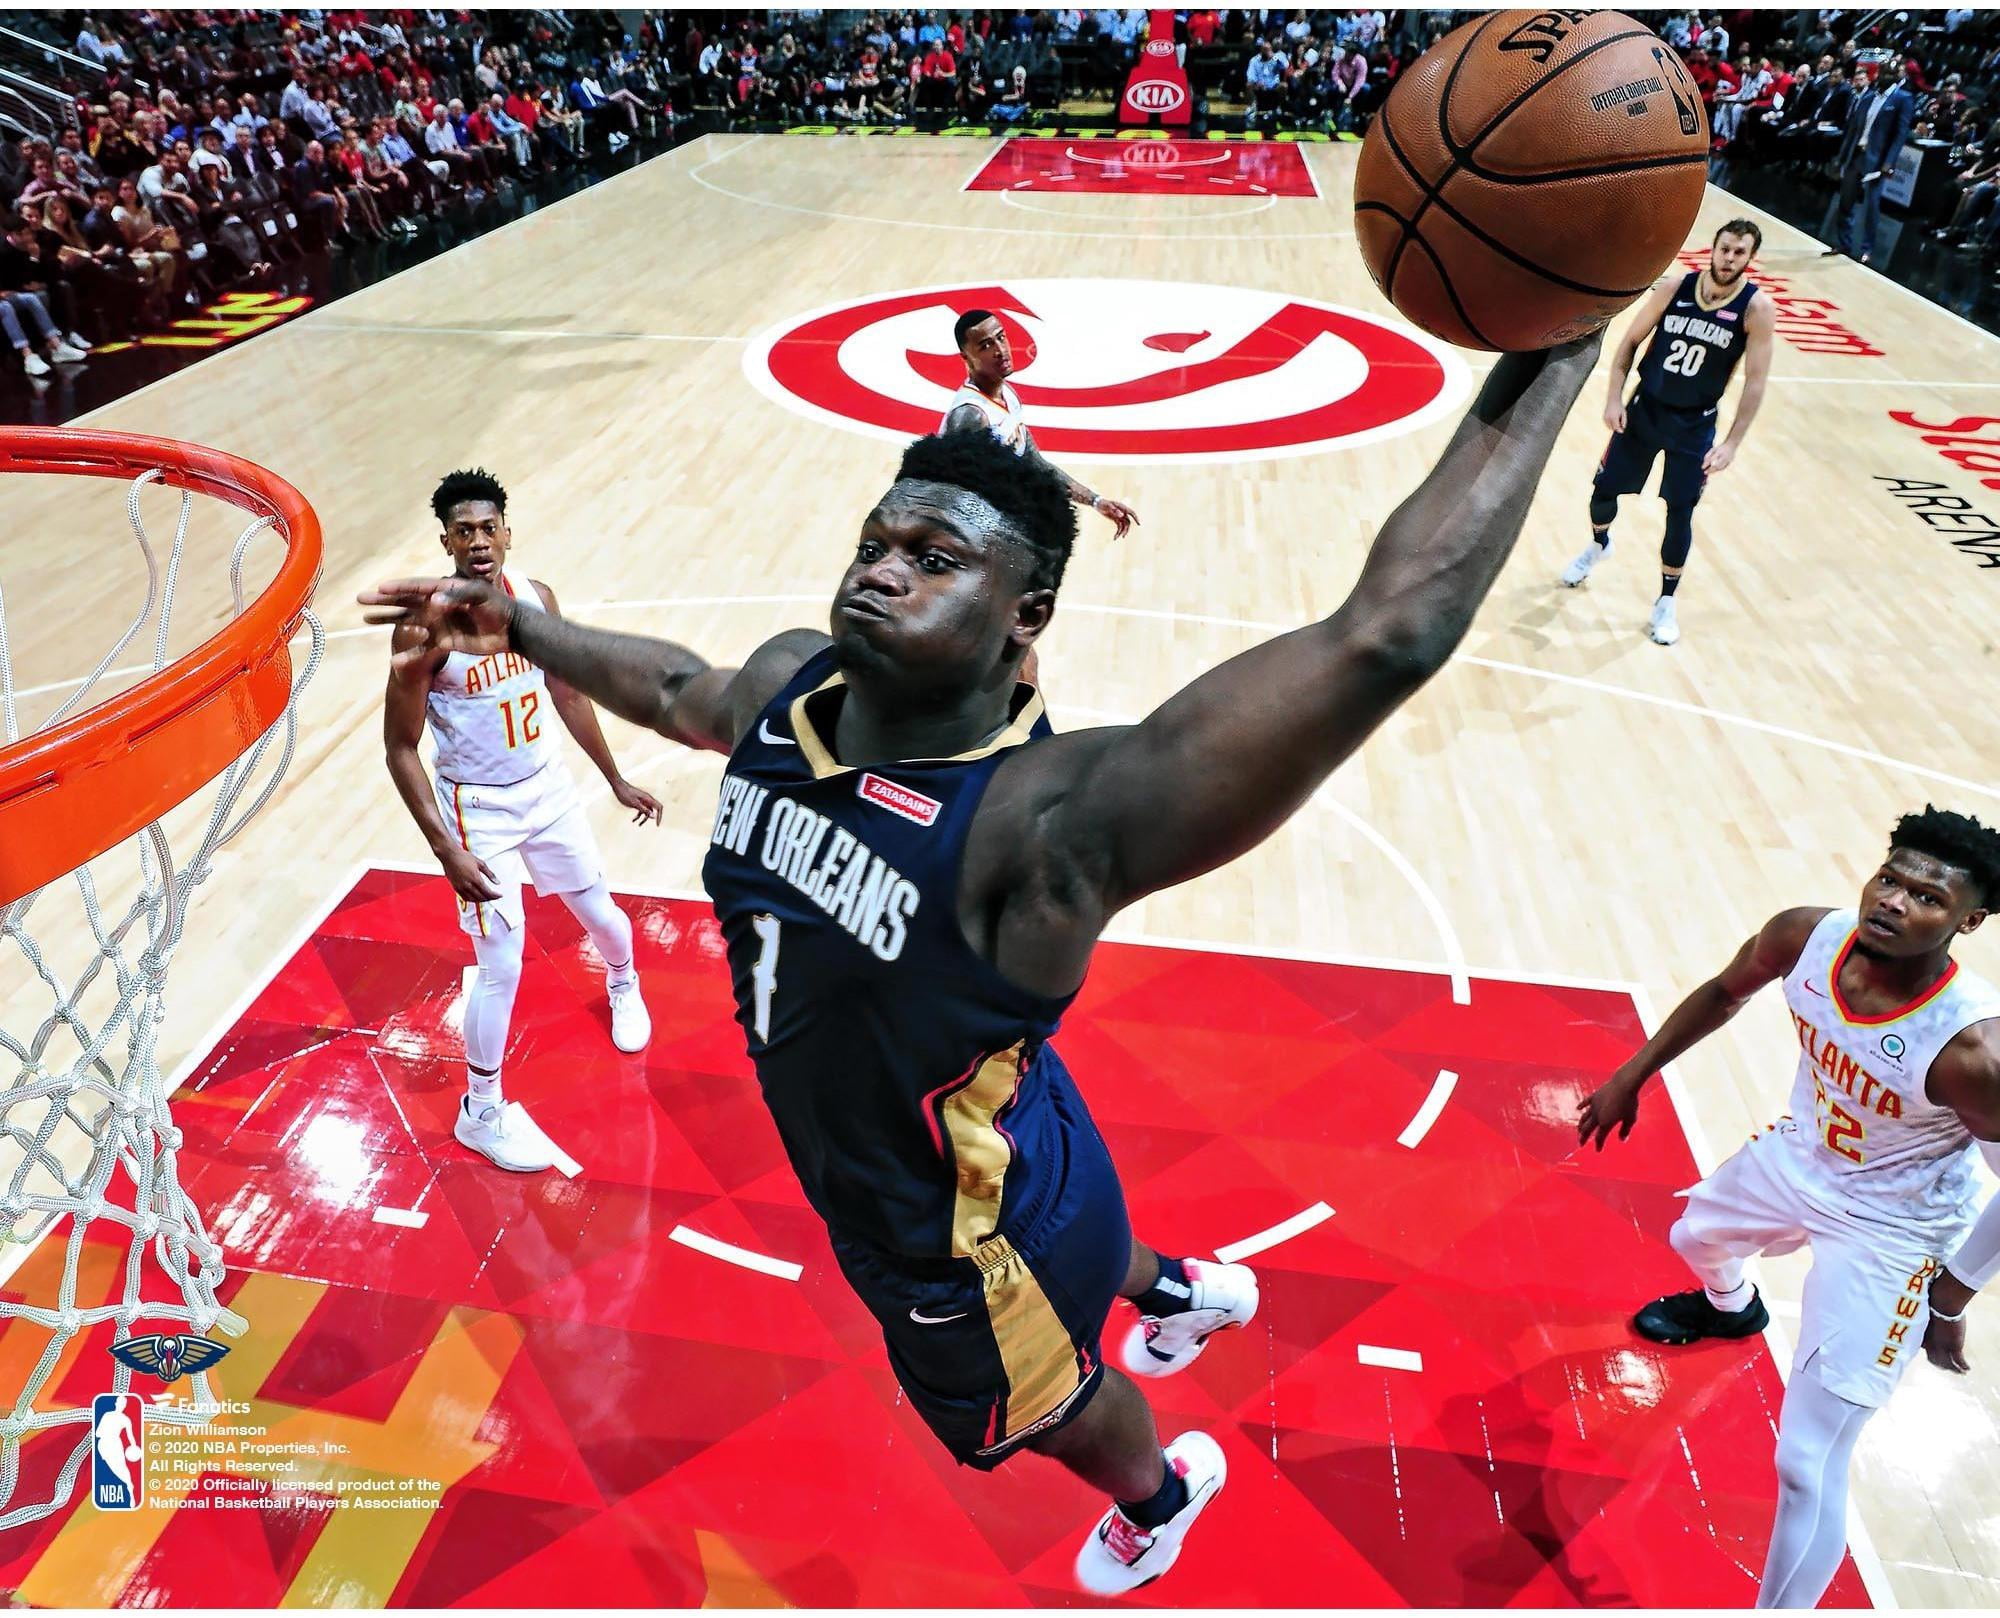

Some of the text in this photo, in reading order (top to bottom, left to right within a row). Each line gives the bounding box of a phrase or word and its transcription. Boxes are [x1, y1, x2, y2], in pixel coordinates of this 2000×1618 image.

[1136, 86, 1175, 106] KIA
[1590, 86, 1629, 112] OFFICIAL
[1646, 76, 1664, 95] BALL
[1662, 339, 1707, 377] 20
[1663, 314, 1690, 335] NEW
[1888, 410, 2000, 490] Sta
[498, 691, 541, 750] 12
[761, 796, 920, 962] ORLEANS
[751, 912, 781, 1045] 1
[1789, 1007, 1903, 1119] TLANTA
[1877, 1257, 1938, 1366] HAWKS
